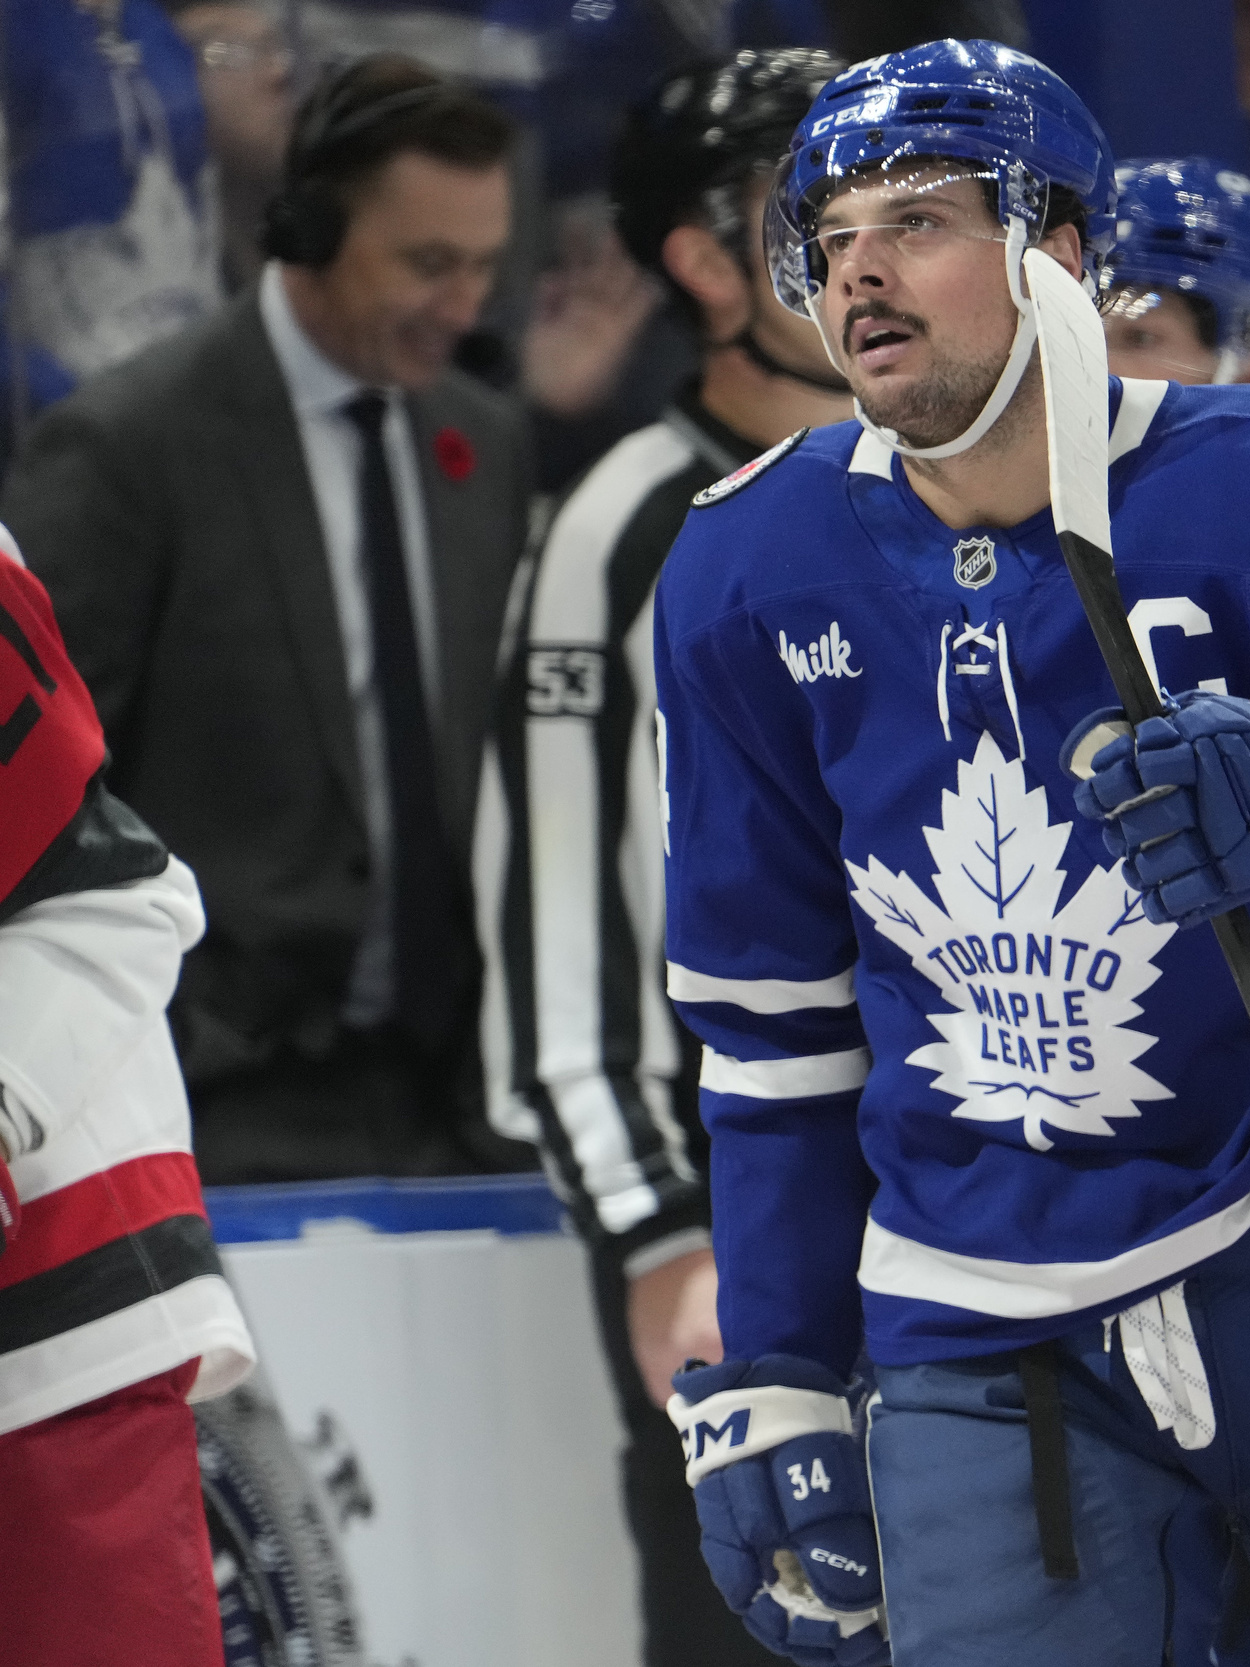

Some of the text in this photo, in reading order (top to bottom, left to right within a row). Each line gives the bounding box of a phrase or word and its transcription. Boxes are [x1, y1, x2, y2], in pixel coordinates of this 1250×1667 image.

[963, 551, 988, 579] NHL
[1127, 597, 1229, 705] C
[527, 650, 604, 716] 53
[927, 932, 1121, 992] TORONTO
[967, 983, 1089, 1028] MAPLE
[981, 1022, 1095, 1074] LEAFS
[787, 1457, 832, 1501] 34
[810, 1547, 868, 1578] CCM
